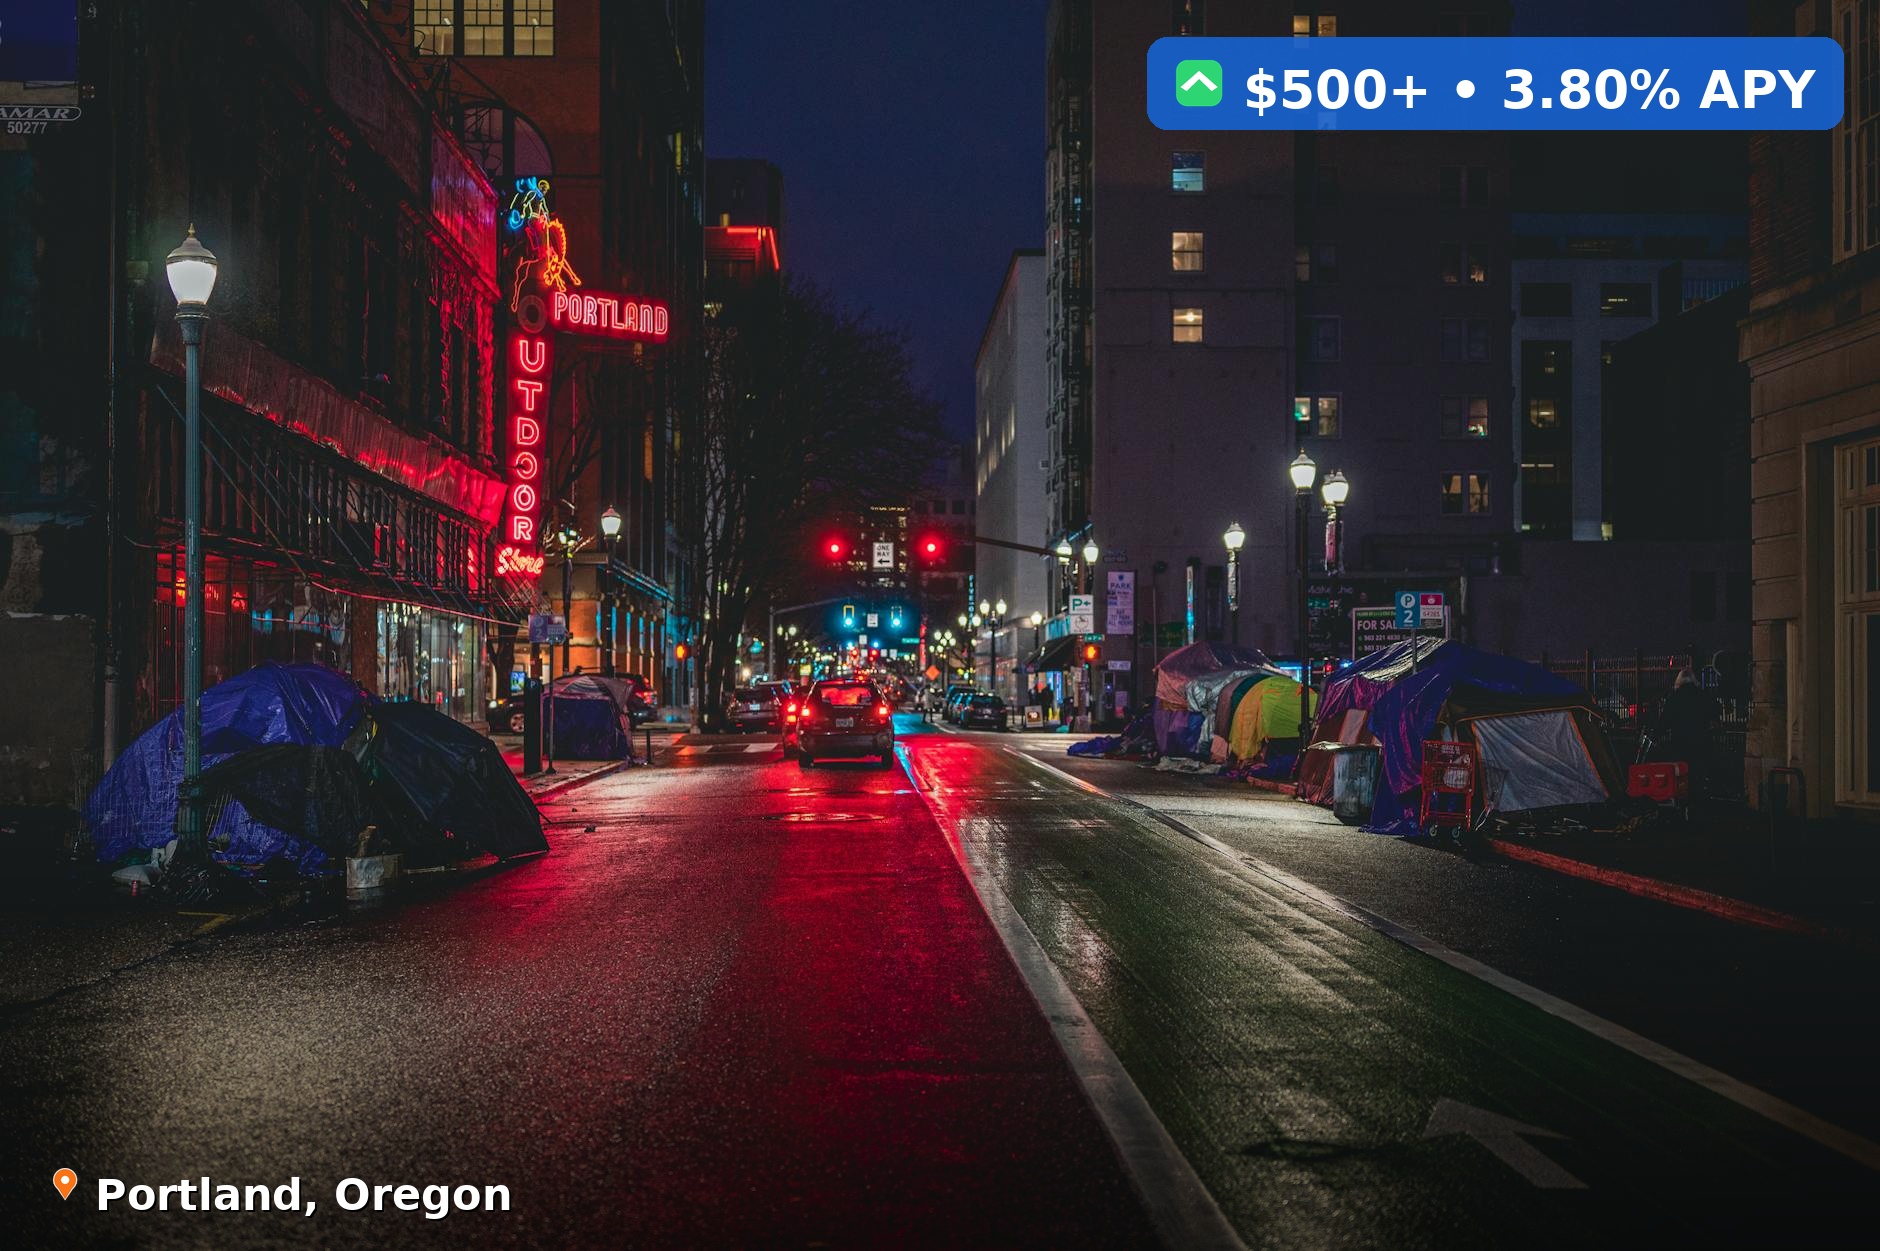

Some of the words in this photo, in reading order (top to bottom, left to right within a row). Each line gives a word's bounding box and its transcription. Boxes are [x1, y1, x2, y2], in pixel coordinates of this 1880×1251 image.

[7, 121, 48, 134] 50277
[554, 291, 669, 336] PORTLAND
[512, 294, 549, 541] OUTDOOR
[1072, 598, 1083, 611] P
[1404, 596, 1412, 606] P
[1403, 610, 1414, 623] 2
[1357, 620, 1378, 631] FOR
[1379, 619, 1396, 631] SAL
